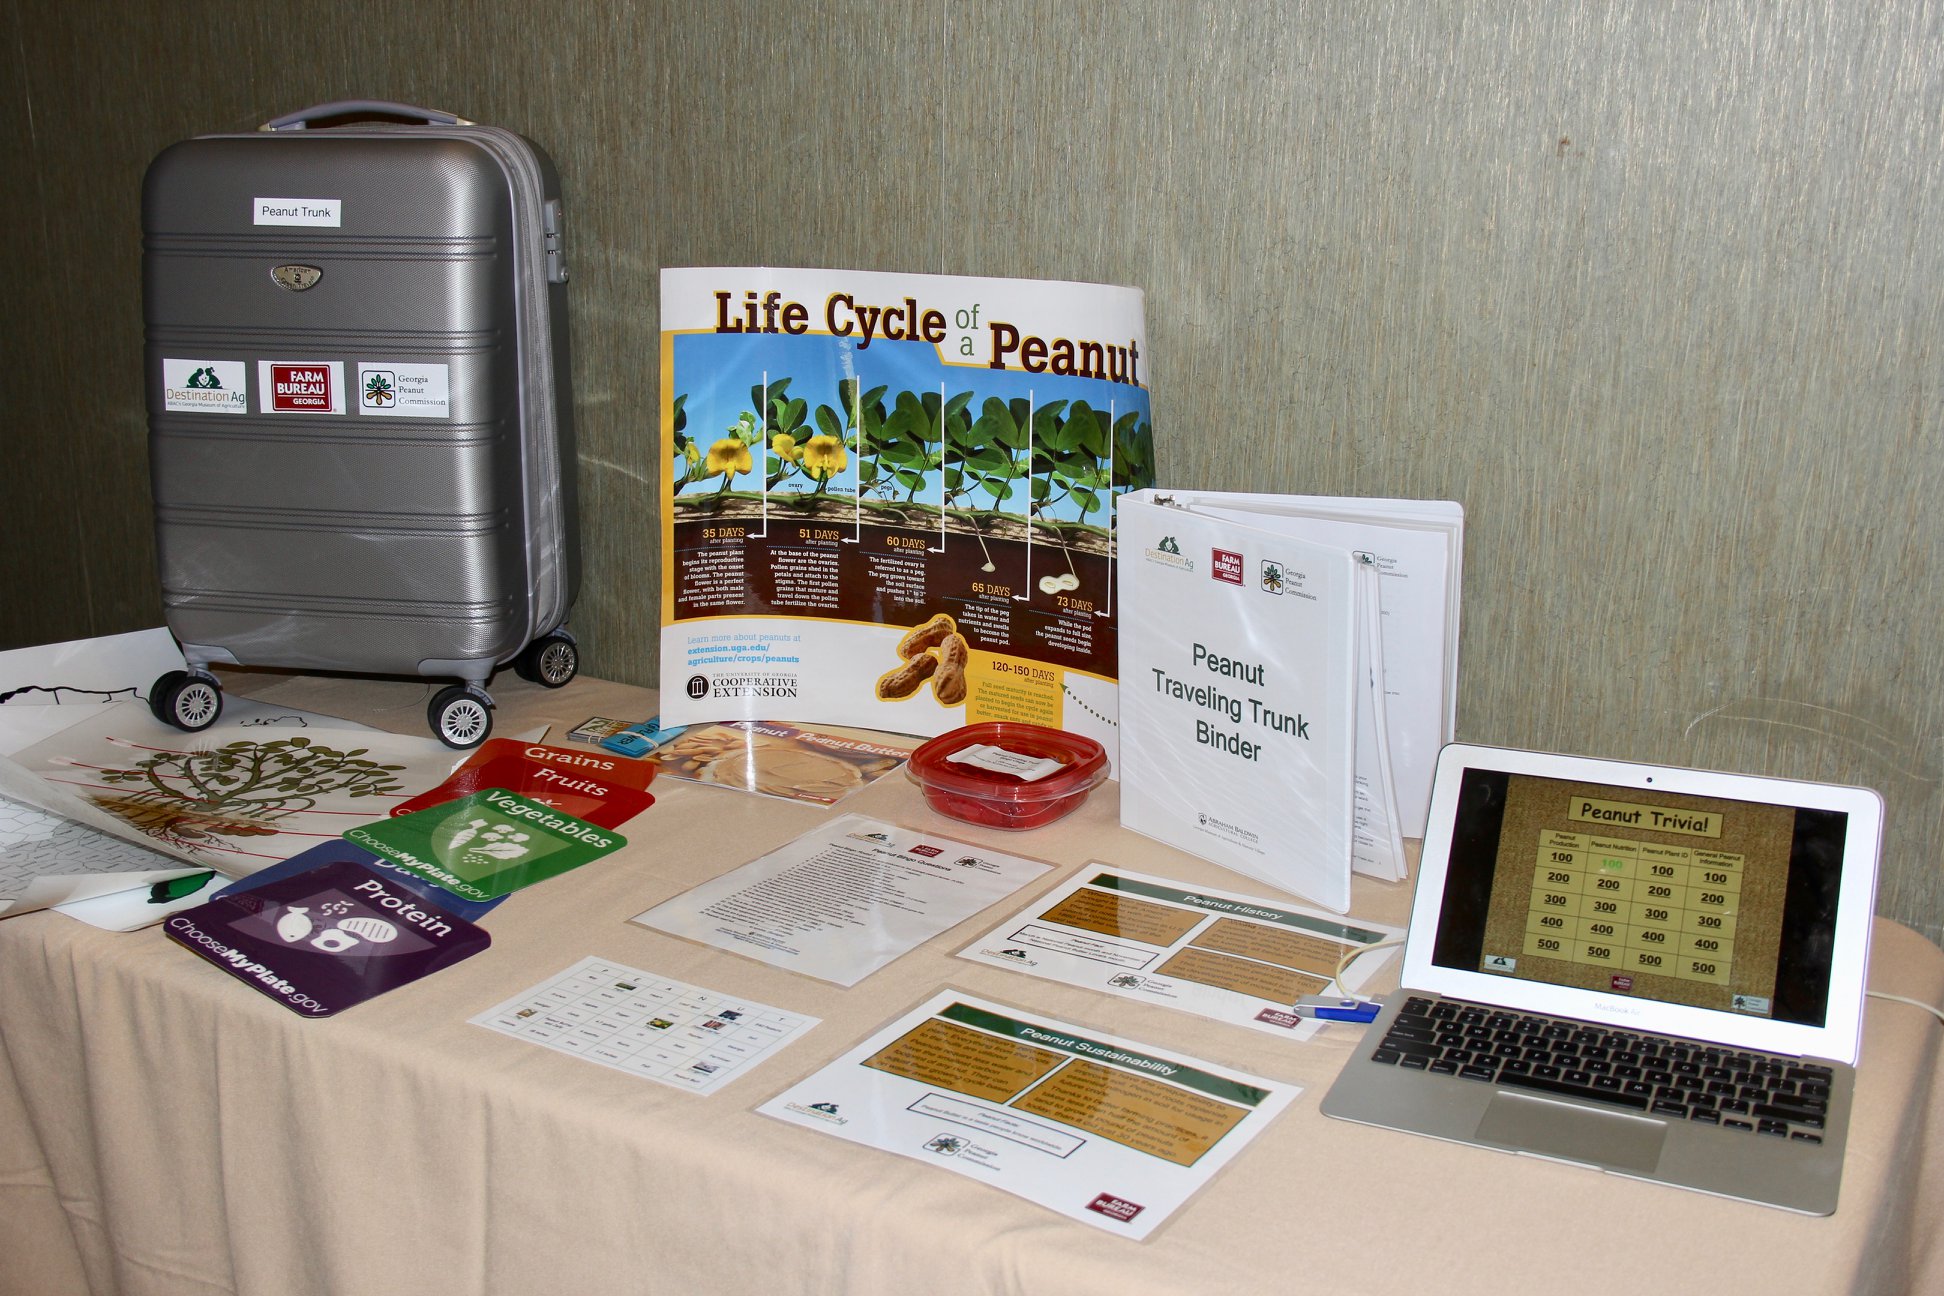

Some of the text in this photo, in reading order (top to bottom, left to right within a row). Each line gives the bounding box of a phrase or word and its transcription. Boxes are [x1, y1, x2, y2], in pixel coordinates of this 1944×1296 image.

[262, 205, 332, 218] Peanut Trunk
[714, 290, 980, 350] Life Cycle of
[960, 321, 1140, 387] a Peanut
[290, 371, 324, 383] FARM
[398, 374, 429, 385] Georgia
[277, 382, 325, 395] BUREAU
[398, 385, 425, 395] Peanut
[166, 388, 245, 404] Destination Ag
[292, 397, 325, 406] GEORGIA
[398, 397, 447, 407] Commission
[182, 401, 198, 409] Georgia
[221, 402, 245, 411] Agriculture
[788, 482, 804, 490] ovary
[827, 486, 857, 495] pollen tube
[880, 485, 893, 493] pegs
[702, 527, 745, 539] 35 DAYS
[799, 528, 840, 541] 51 DAYS
[818, 540, 838, 548] planting
[886, 536, 926, 550] 60 DAYS
[709, 550, 728, 558] peanut
[905, 548, 925, 557] planting
[1145, 548, 1185, 566] Destination
[1184, 558, 1194, 570] Ag
[708, 557, 744, 565] reproductive
[1221, 554, 1240, 566] FARM
[789, 564, 807, 572] grains
[1214, 560, 1241, 575] BUREAU
[1285, 568, 1306, 580] Georgia
[1285, 577, 1303, 588] Peanut
[972, 582, 1011, 597] 65 DAYS
[1284, 587, 1317, 601] Commission
[1057, 595, 1093, 612] 73 DAYS
[687, 636, 709, 645] Learn
[734, 633, 756, 642] about
[760, 634, 791, 643] peanuts
[687, 643, 770, 655] extension.uga.edu/
[687, 653, 800, 667] agriculture/crops/peanuts
[1193, 643, 1265, 687] Peanut
[992, 661, 1055, 682] 120-150 DAYS
[712, 677, 798, 687] COOPERATIVE
[713, 687, 798, 699] EXTENSION
[1152, 668, 1310, 740] Traveling Trunk
[730, 721, 789, 738] Peanut
[795, 732, 911, 758] Peanut Butter
[1196, 719, 1262, 762] Binder
[524, 747, 615, 772] Grains
[533, 768, 609, 797] Fruits
[486, 790, 613, 849] Vegetables
[1581, 802, 1709, 832] Peanut Trivia!
[1555, 832, 1576, 842] Peanut
[1549, 839, 1580, 849] Production
[1590, 840, 1637, 853] Peanut Nutrition
[1551, 852, 1573, 863] 100
[1642, 847, 1689, 859] Peanut Plant ID
[1693, 850, 1741, 862] General Peanut
[349, 829, 491, 899] ChooseMyPlate.gov
[871, 848, 896, 859] Peanut
[917, 859, 952, 872] Questions
[1602, 859, 1623, 870] 100
[1699, 858, 1734, 868] Information
[1547, 872, 1570, 884] 200
[1651, 865, 1674, 878] 100
[1597, 879, 1620, 891] 200
[1703, 872, 1727, 885] 100
[1648, 886, 1671, 898] 200
[1544, 894, 1567, 907] 300
[1700, 893, 1725, 905] 200
[353, 879, 452, 938] Protein
[1183, 895, 1283, 920] Peanut History
[1593, 901, 1617, 914] 300
[1645, 908, 1668, 921] 300
[1540, 916, 1563, 929] 400
[1697, 916, 1722, 929] 300
[1590, 923, 1614, 936] 400
[1641, 931, 1665, 944] 400
[1537, 938, 1560, 951] 500
[1694, 939, 1719, 952] 400
[1587, 946, 1610, 959] 500
[170, 917, 328, 1013] ChooseMyPlate.gov
[1638, 954, 1662, 967] 500
[1691, 962, 1716, 976] 500
[1020, 1027, 1178, 1076] Peanut Sustainability
